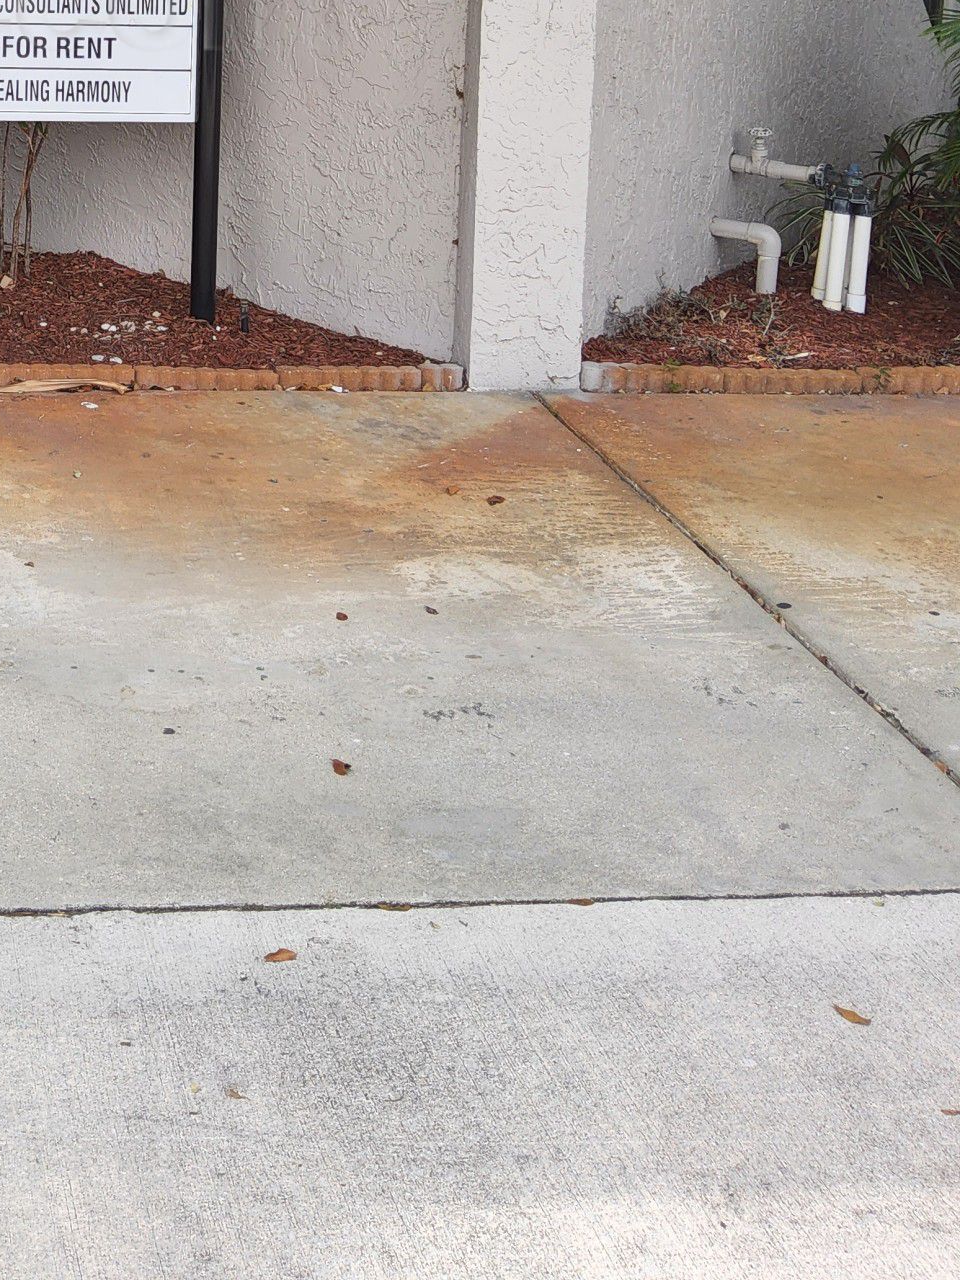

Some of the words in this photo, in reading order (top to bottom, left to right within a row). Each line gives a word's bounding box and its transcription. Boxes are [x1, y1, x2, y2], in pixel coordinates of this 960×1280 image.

[2, 35, 47, 59] FOR
[56, 36, 117, 60] RENT
[55, 80, 132, 103] HARMONY
